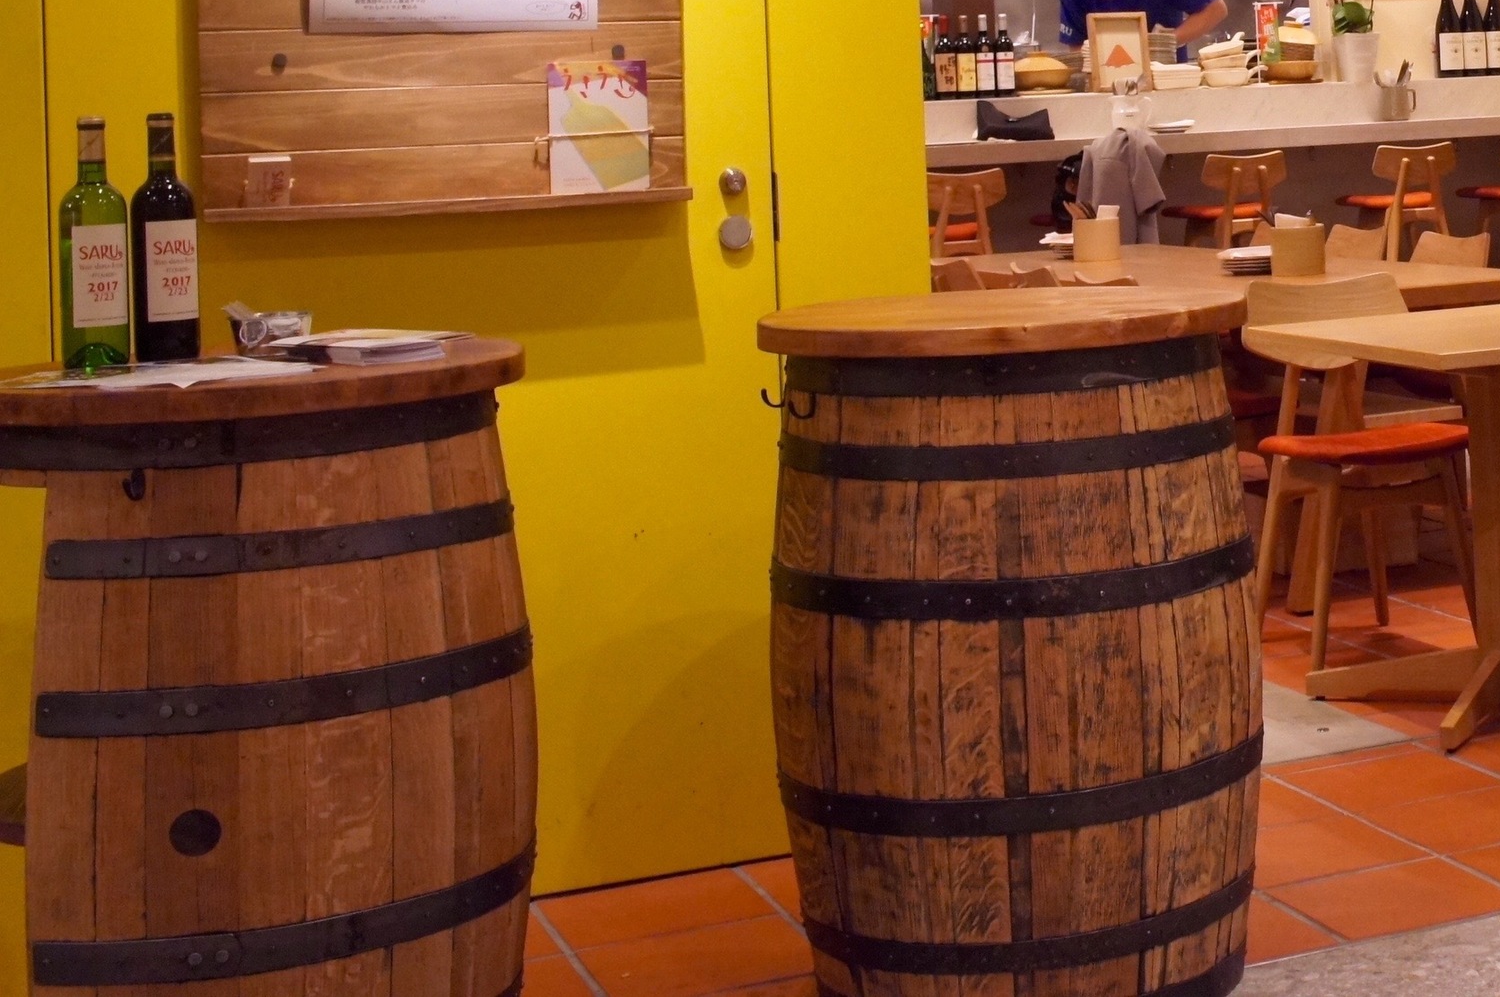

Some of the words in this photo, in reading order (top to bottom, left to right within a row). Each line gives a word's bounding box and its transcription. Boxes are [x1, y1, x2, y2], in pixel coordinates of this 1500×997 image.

[79, 244, 123, 261] SARU
[153, 239, 194, 256] SARU
[88, 281, 118, 292] 2017
[162, 276, 191, 289] 2017
